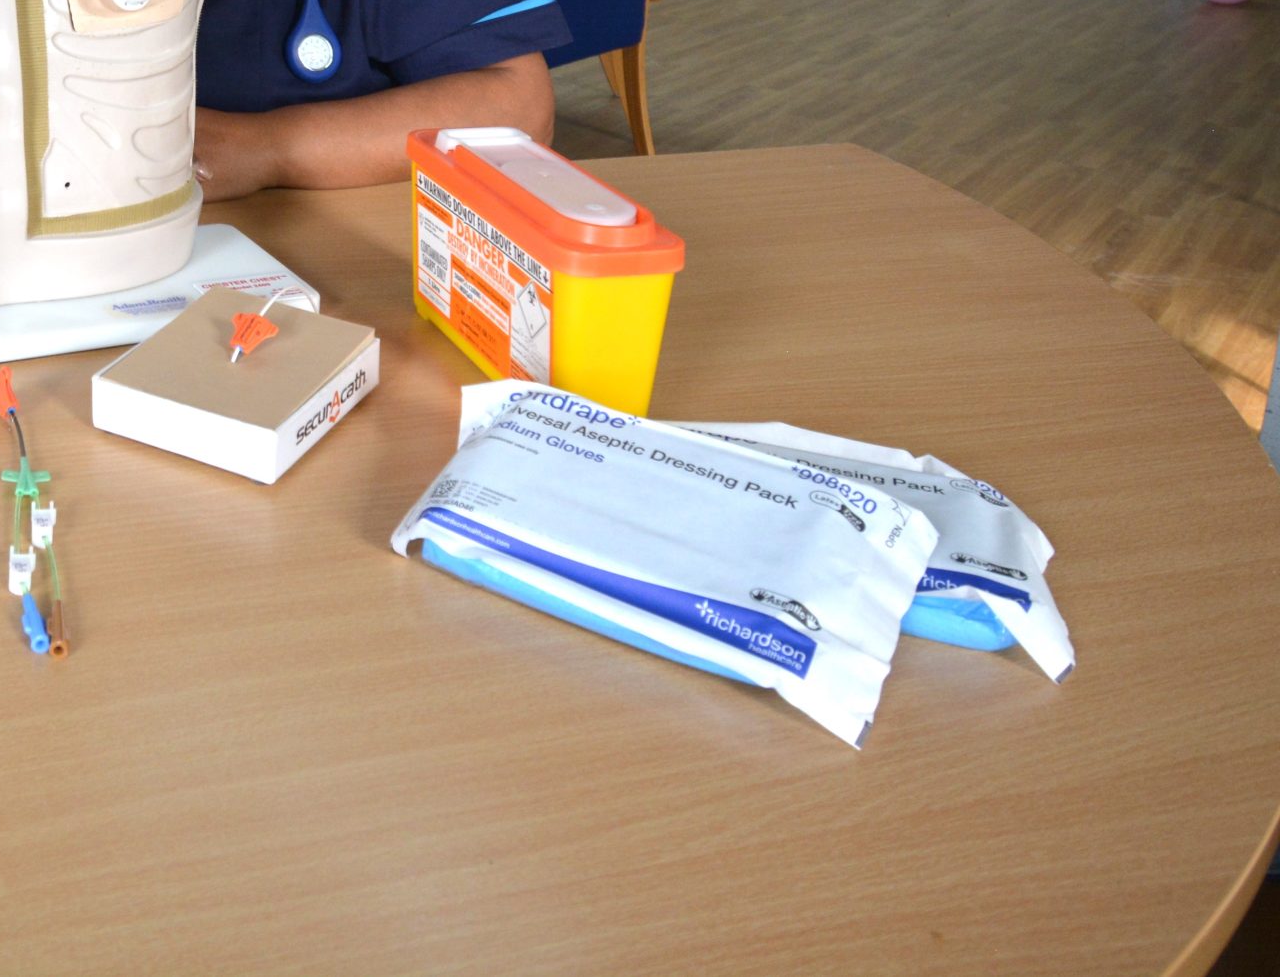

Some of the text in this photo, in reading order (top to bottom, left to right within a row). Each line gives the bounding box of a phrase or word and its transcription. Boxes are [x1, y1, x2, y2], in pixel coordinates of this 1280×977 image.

[423, 178, 452, 208] WARNING
[477, 217, 489, 237] FILL
[490, 227, 512, 256] ABOVE
[513, 244, 526, 267] THE
[527, 256, 541, 280] LINE
[456, 218, 505, 273] DANGER
[295, 368, 367, 446] securAcath
[545, 435, 606, 463] Gloves
[572, 425, 646, 456] Aseptic
[650, 449, 739, 490] Dressing
[744, 481, 799, 510] Pack
[892, 477, 945, 496] Pack
[884, 524, 903, 549] OPEN
[705, 612, 807, 664] richardson
[748, 642, 804, 671] healthcare
